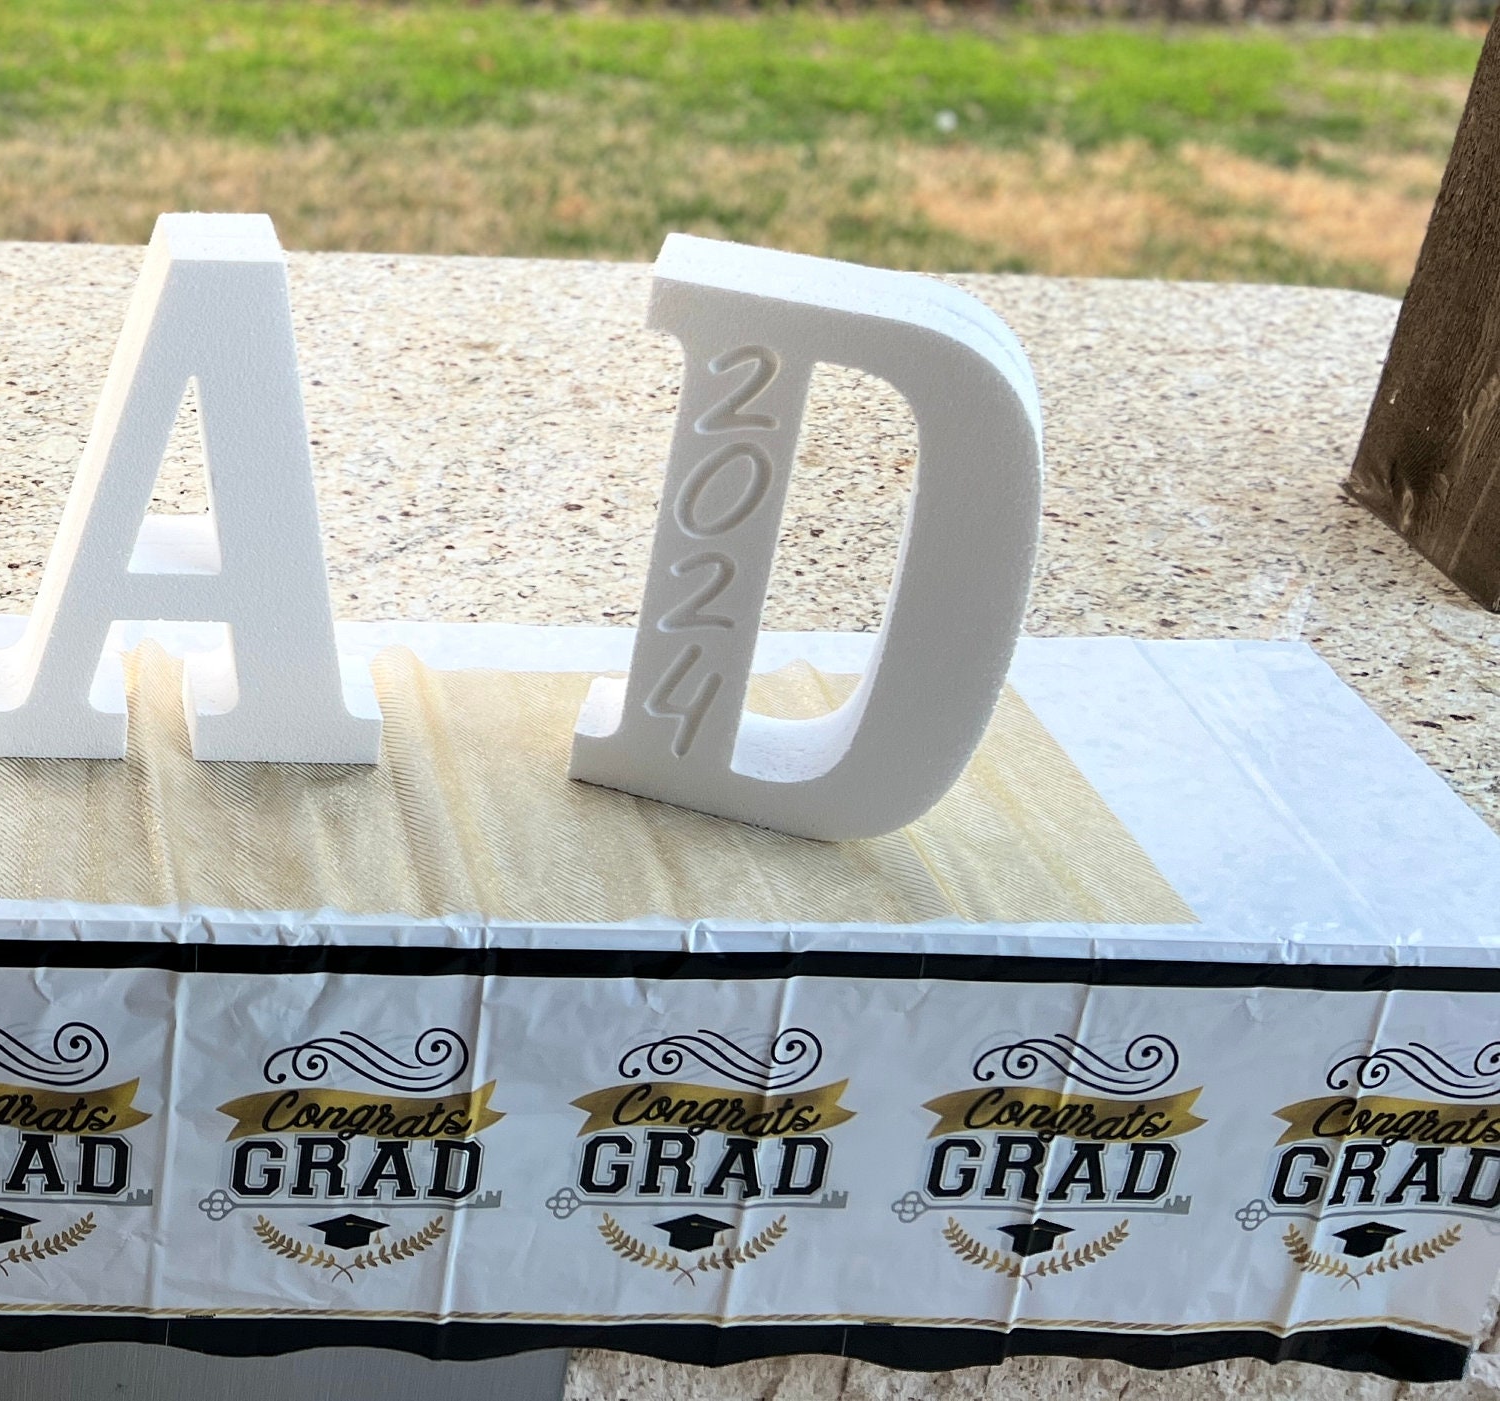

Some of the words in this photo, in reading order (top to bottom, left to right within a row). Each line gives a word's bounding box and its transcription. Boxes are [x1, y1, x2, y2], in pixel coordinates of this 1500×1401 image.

[642, 343, 783, 761] 2024
[262, 1089, 472, 1139] Congrats
[612, 1083, 822, 1138] Congrats
[963, 1088, 1173, 1142] Congrats
[228, 1132, 485, 1201] GRAD
[576, 1127, 834, 1202] GRAD
[922, 1134, 1183, 1207] GRAD
[1268, 1138, 1500, 1210] GRAD
